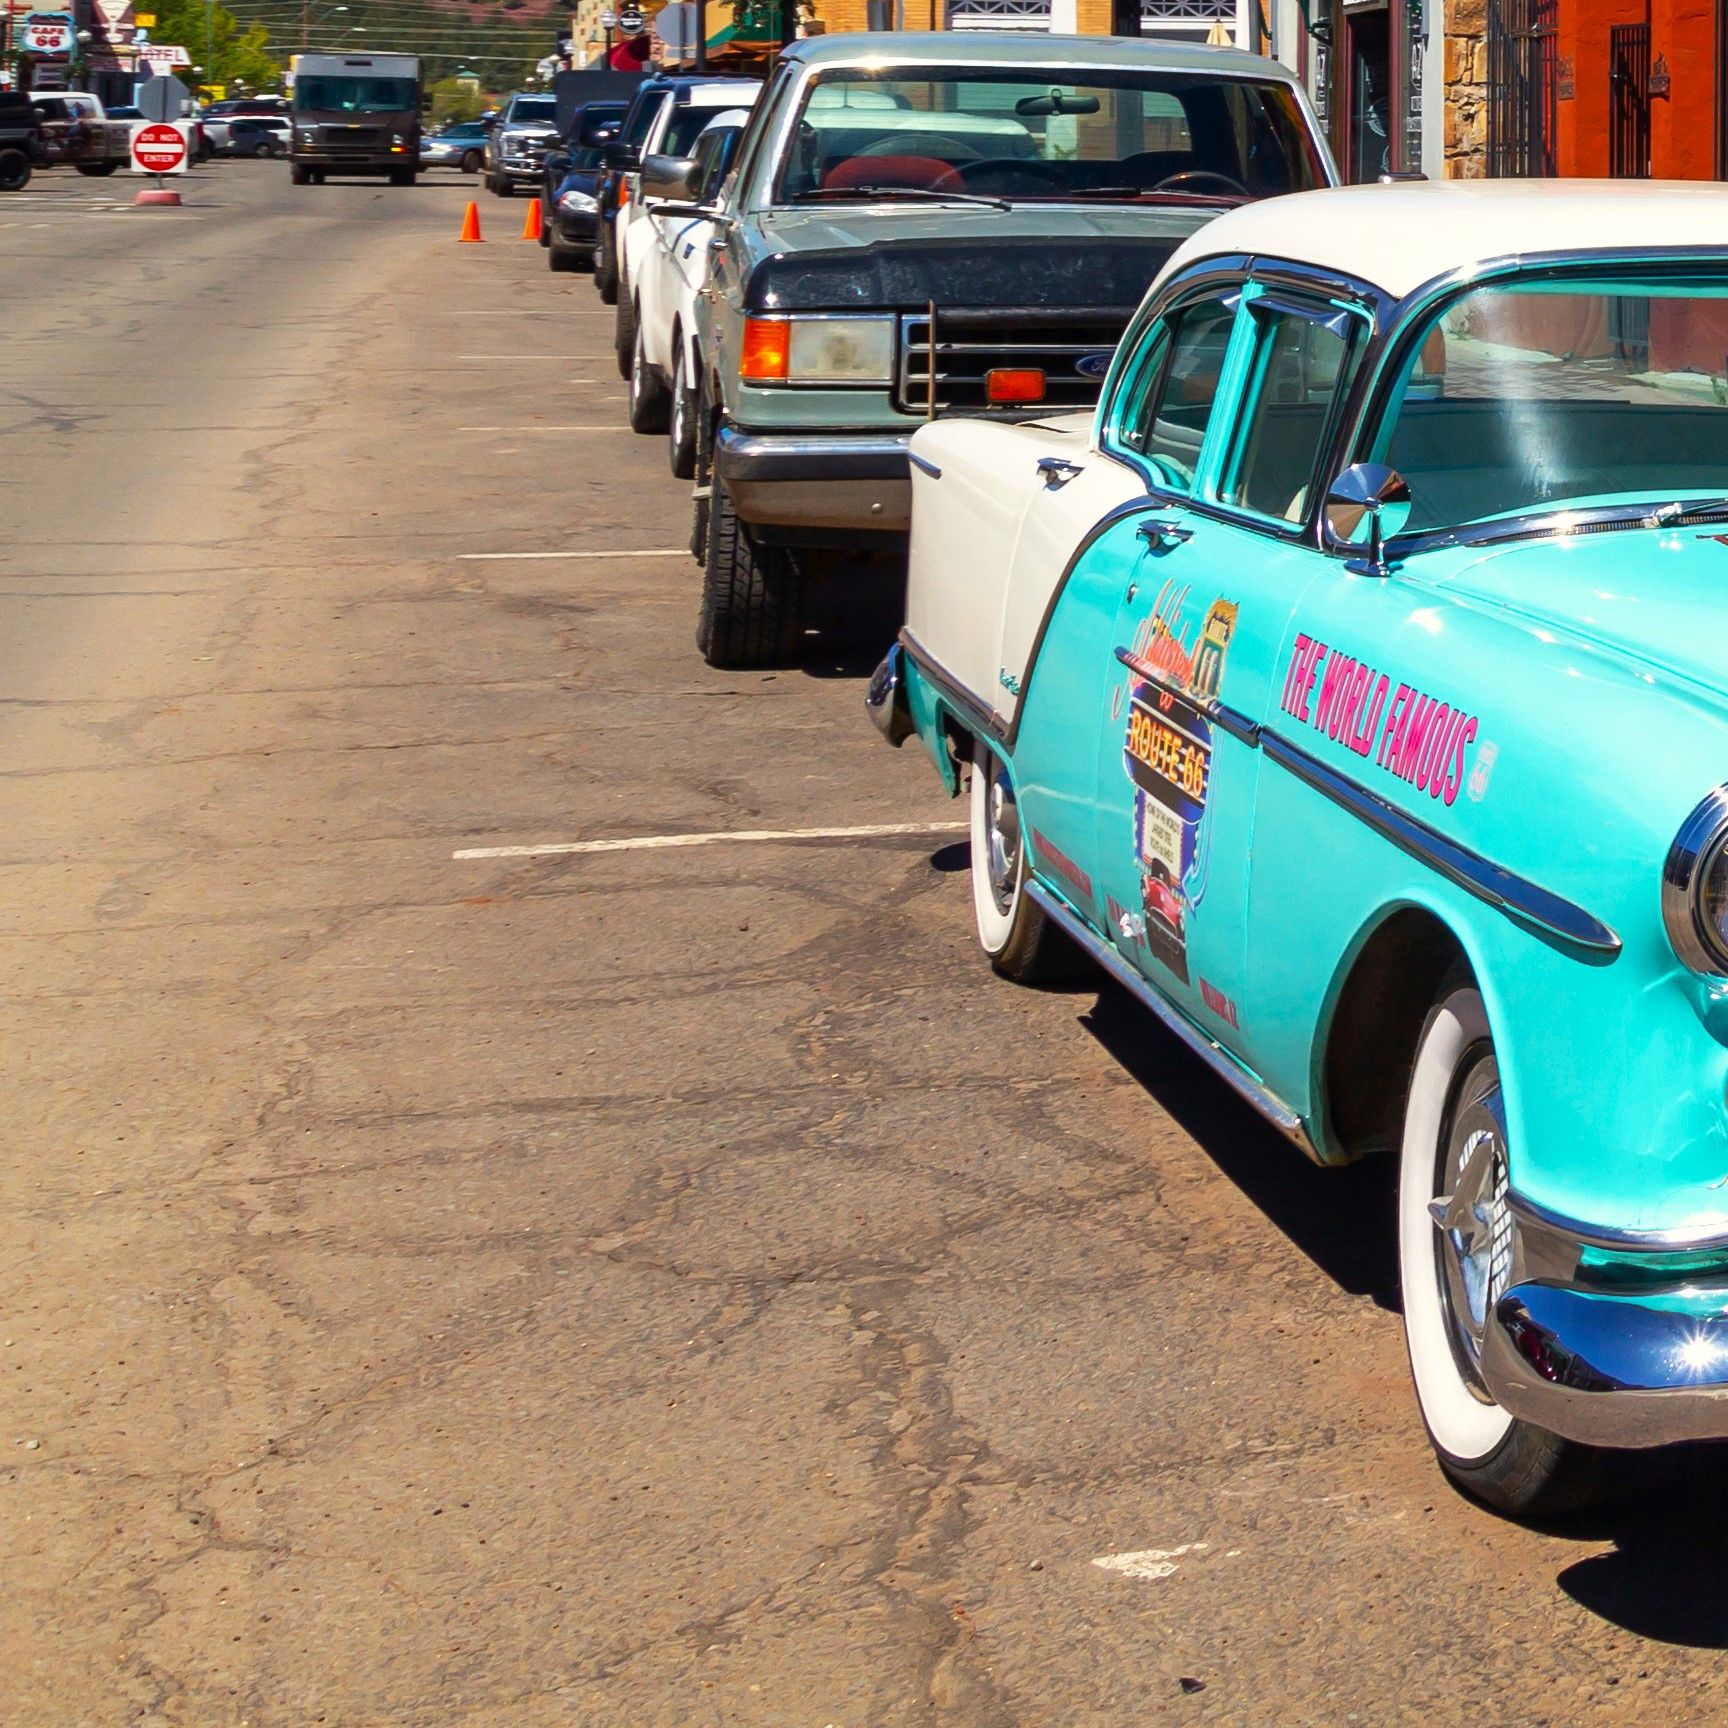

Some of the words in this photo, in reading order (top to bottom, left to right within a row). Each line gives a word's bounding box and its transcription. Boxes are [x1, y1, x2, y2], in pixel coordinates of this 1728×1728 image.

[141, 133, 155, 142] DO
[159, 133, 179, 142] NOT
[143, 153, 175, 163] ENTER
[1280, 632, 1329, 724] THE
[1313, 648, 1391, 759] WORLD
[1375, 681, 1479, 808] FAMOUS
[1129, 708, 1183, 783] ROUTE
[1184, 745, 1205, 798] 66
